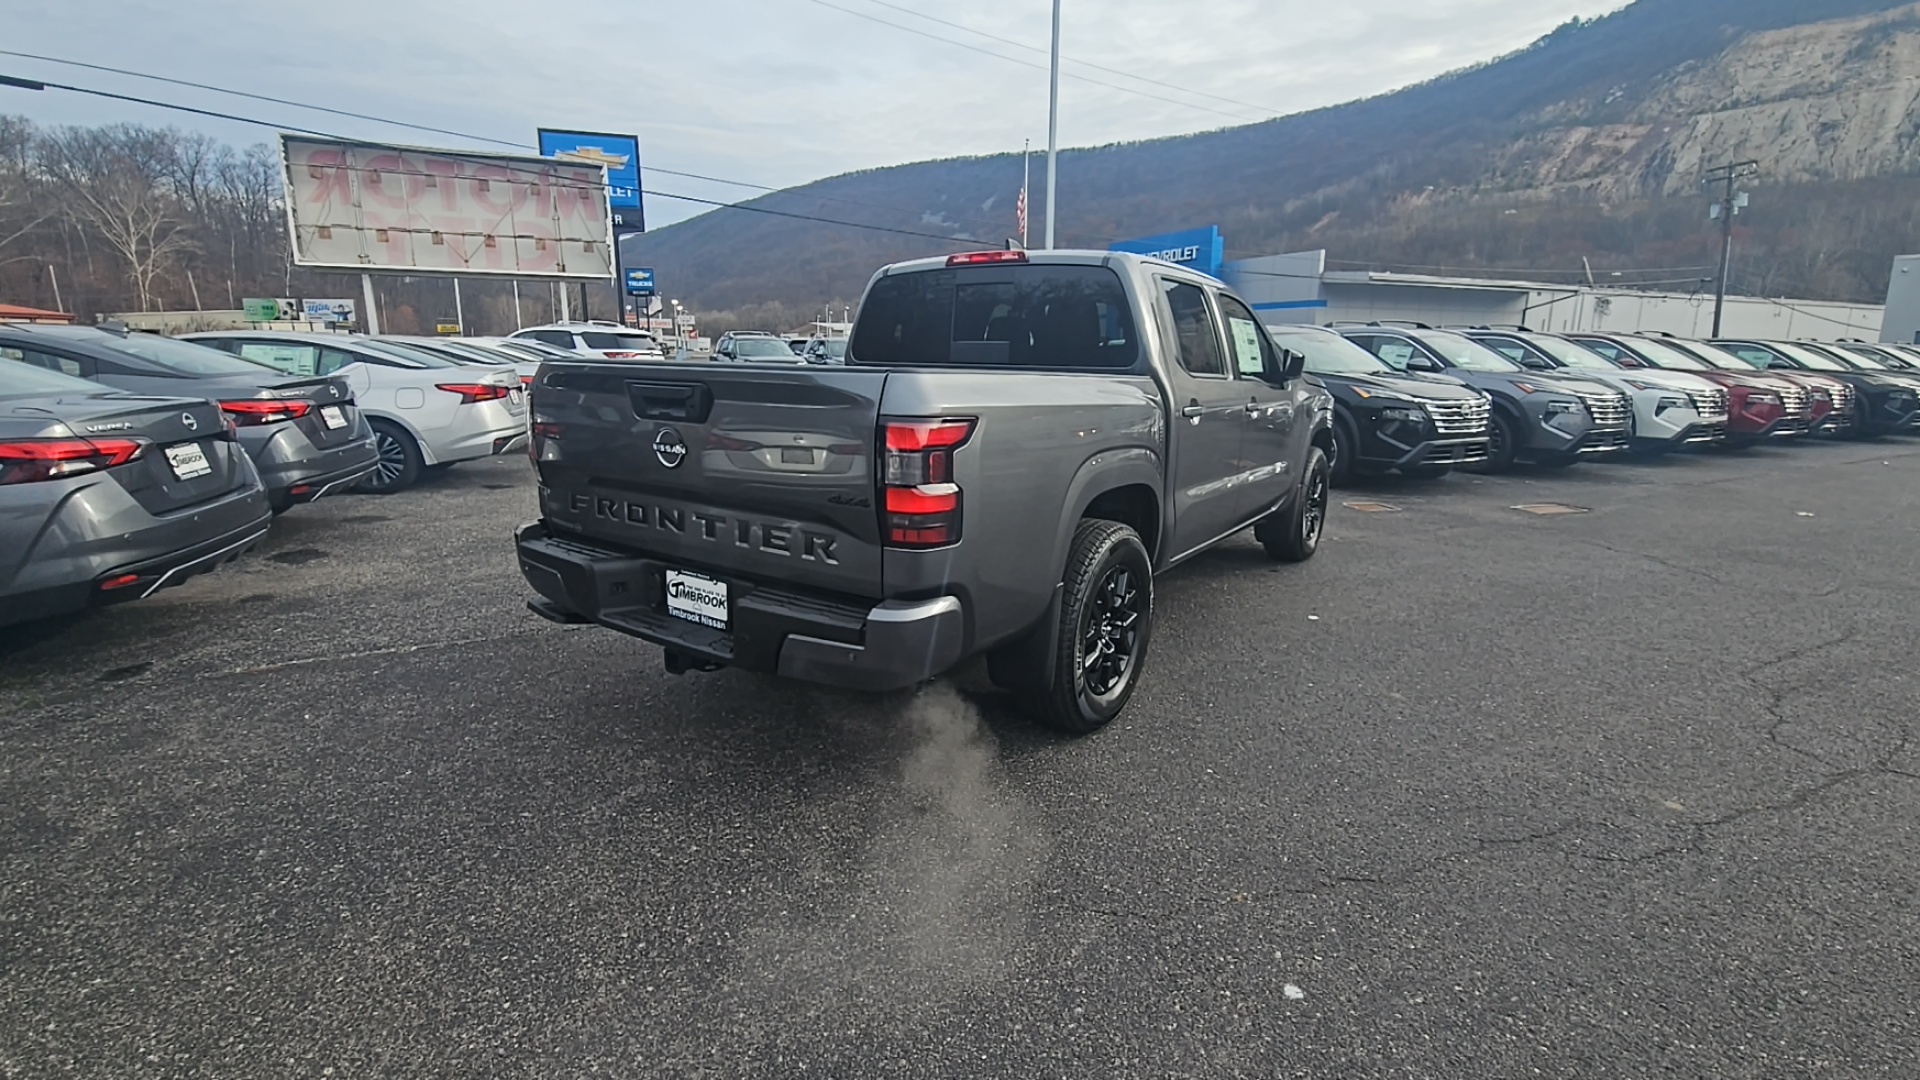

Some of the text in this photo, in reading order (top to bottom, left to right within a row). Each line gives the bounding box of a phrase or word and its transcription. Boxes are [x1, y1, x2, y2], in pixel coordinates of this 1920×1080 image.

[1142, 245, 1199, 262] EVROLET
[652, 443, 686, 454] NISSAN
[569, 490, 840, 565] FRONTIER
[668, 606, 727, 630] Timbrook Nissan
